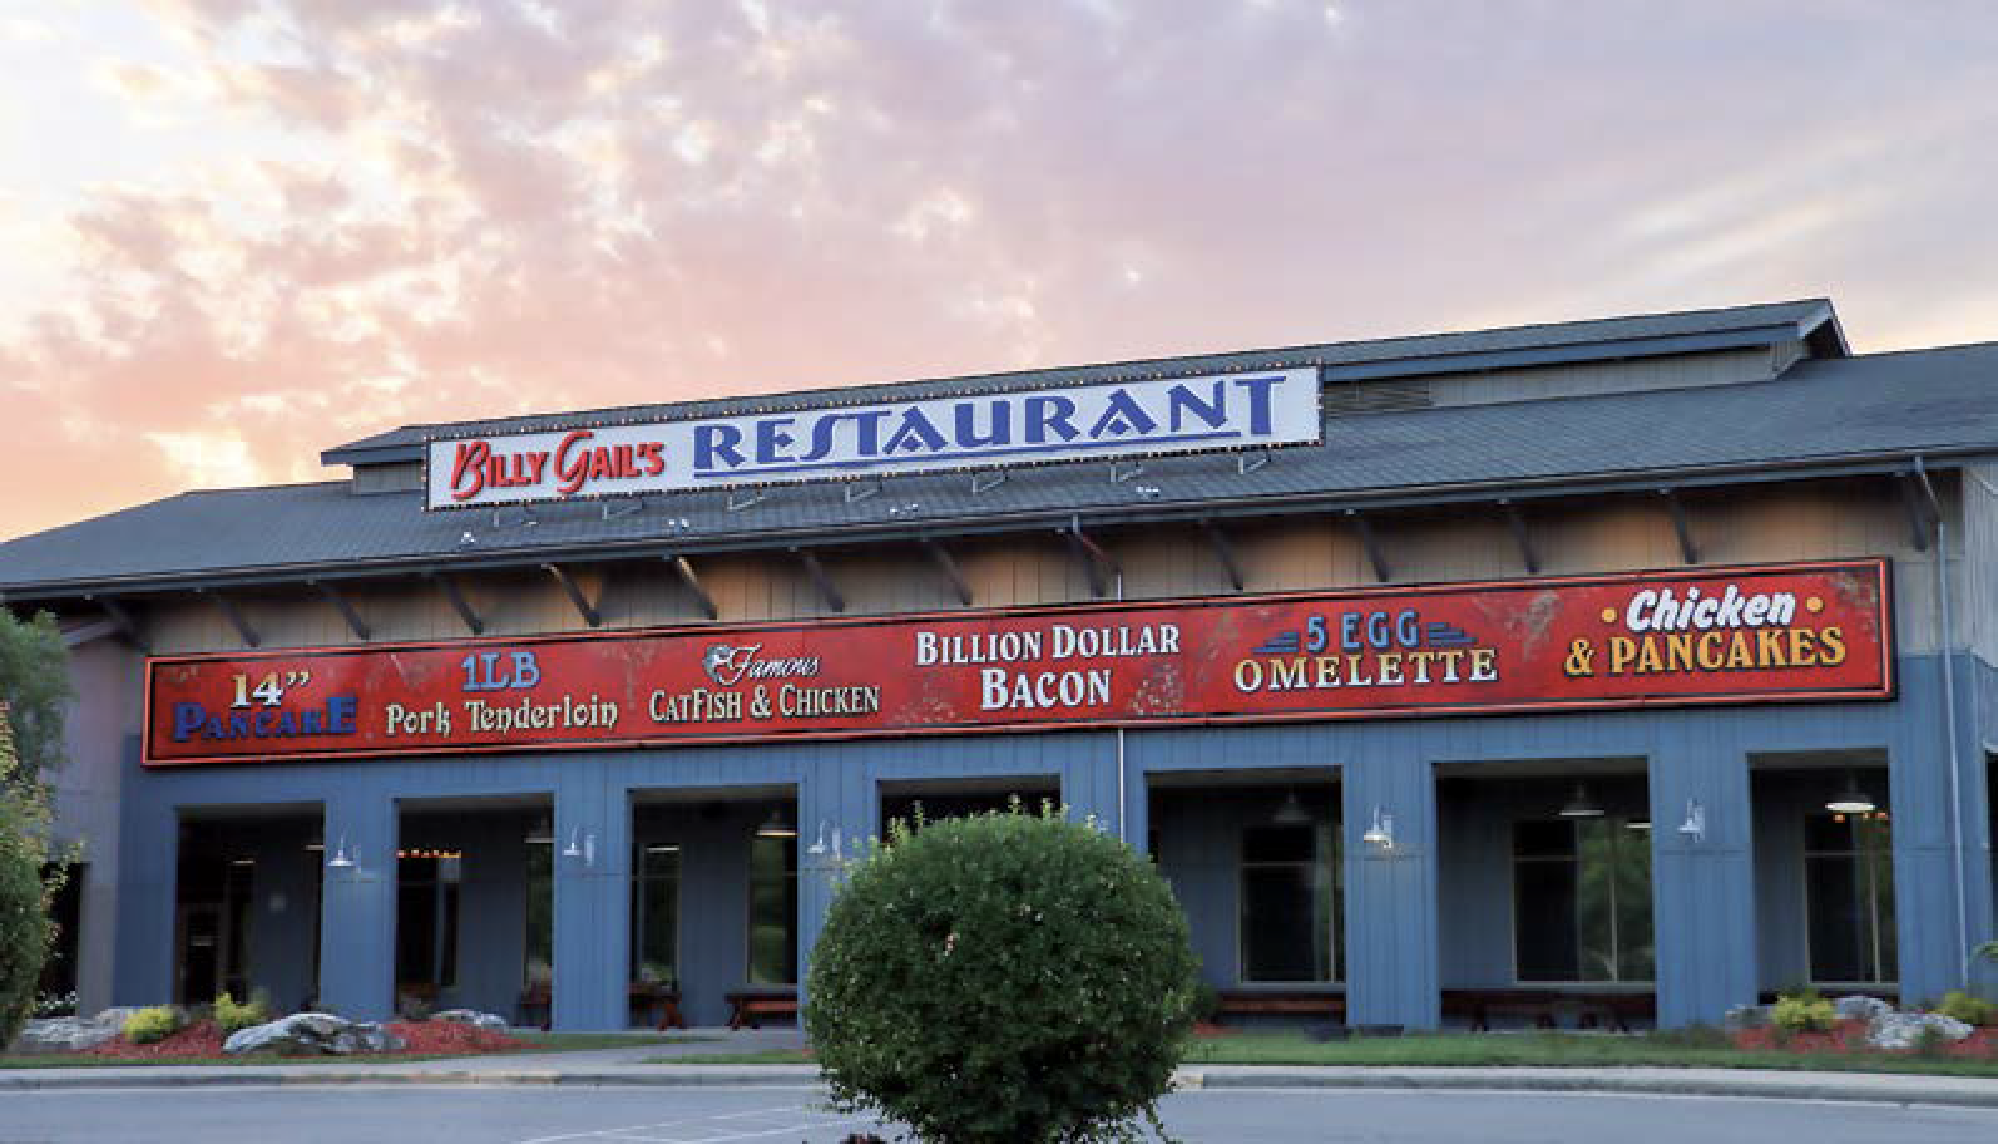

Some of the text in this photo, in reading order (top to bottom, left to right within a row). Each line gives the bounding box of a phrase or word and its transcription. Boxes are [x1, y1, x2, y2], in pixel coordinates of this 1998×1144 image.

[451, 375, 1287, 500] BILLY GAIL'S RESTAURANT
[1305, 609, 1420, 652] 5 EGG
[1625, 585, 1797, 633] Chicken
[712, 642, 822, 686] Famous
[916, 623, 1181, 666] BILLION DOLLAR
[1562, 625, 1847, 677] & PANCAKES
[460, 650, 541, 692] 1LB
[979, 667, 1113, 712] BACON
[1233, 647, 1499, 693] OMELETTE
[173, 694, 358, 742] PANCAKE
[385, 695, 619, 738] Pork Tenderloin
[749, 684, 773, 719] &
[779, 683, 881, 717] CHICKEN
